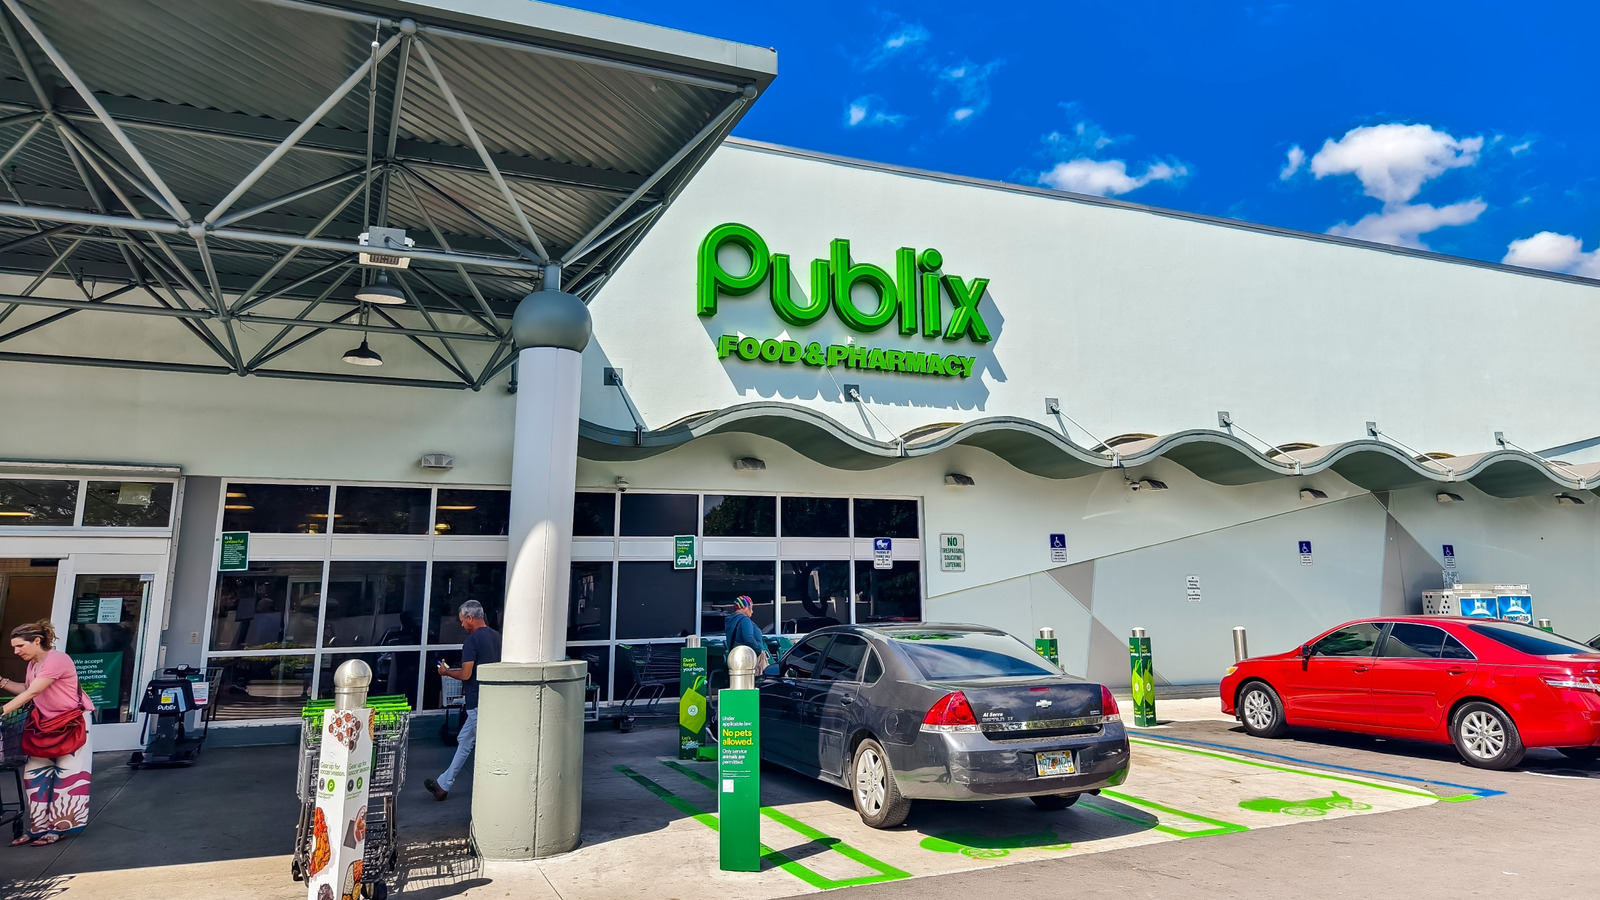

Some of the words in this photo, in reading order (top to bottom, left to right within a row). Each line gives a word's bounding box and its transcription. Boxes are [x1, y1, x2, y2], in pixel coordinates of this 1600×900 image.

[697, 222, 993, 343] Publix
[947, 538, 958, 546] NO
[734, 730, 752, 738] pets
